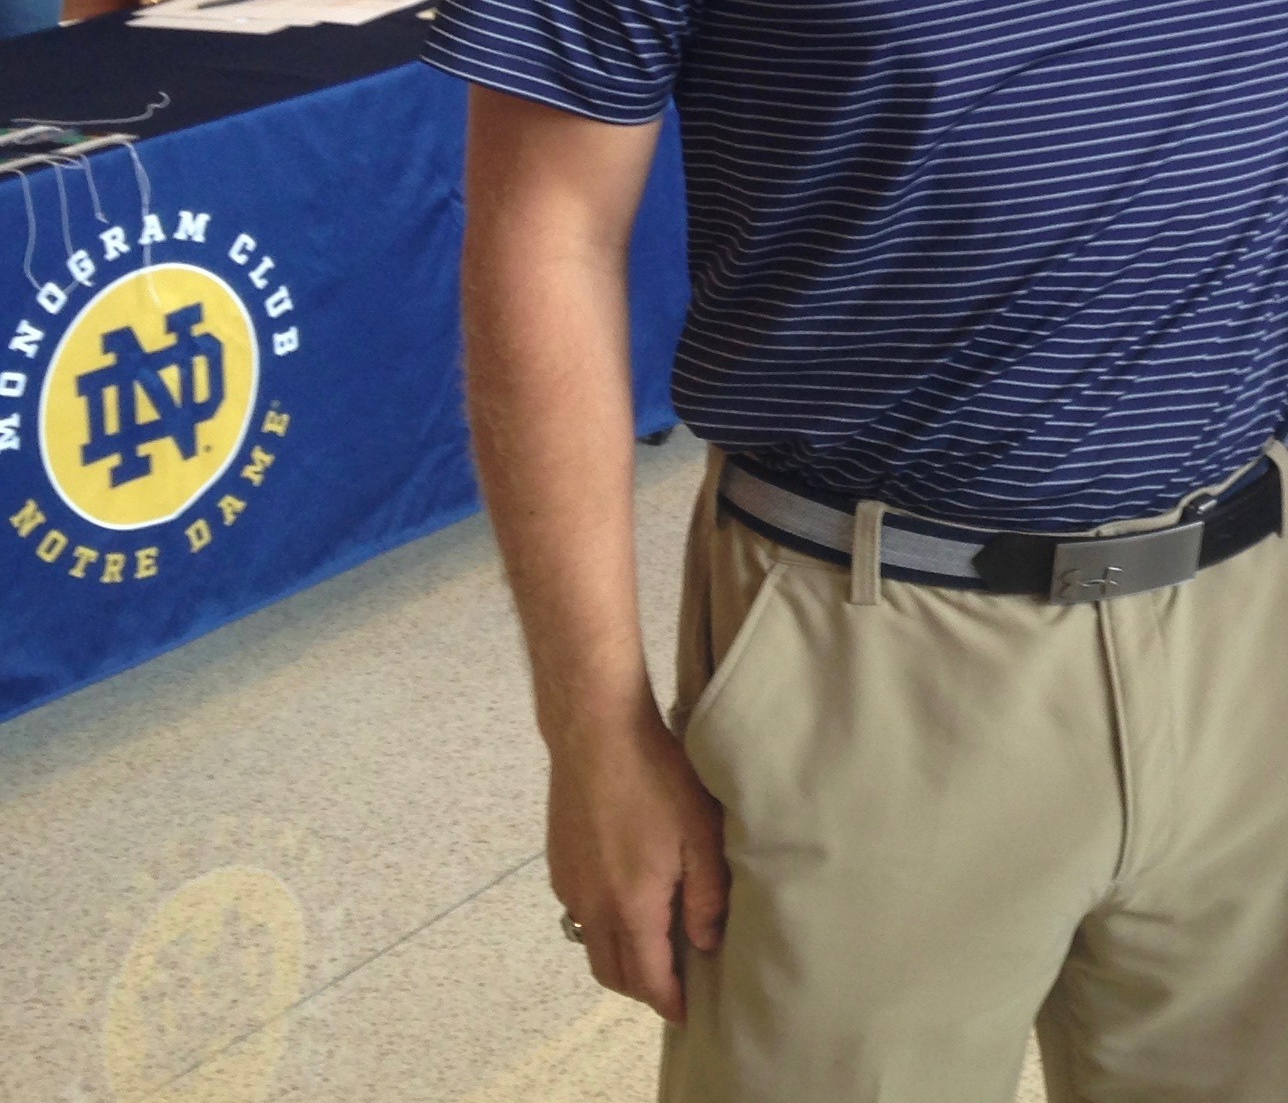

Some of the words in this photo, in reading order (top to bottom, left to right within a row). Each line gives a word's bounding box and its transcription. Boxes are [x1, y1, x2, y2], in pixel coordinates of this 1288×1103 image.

[0, 210, 211, 452] MONOGRAM
[228, 233, 300, 356] CLUB
[8, 499, 160, 583] NOTRE
[185, 408, 291, 552] DAME
